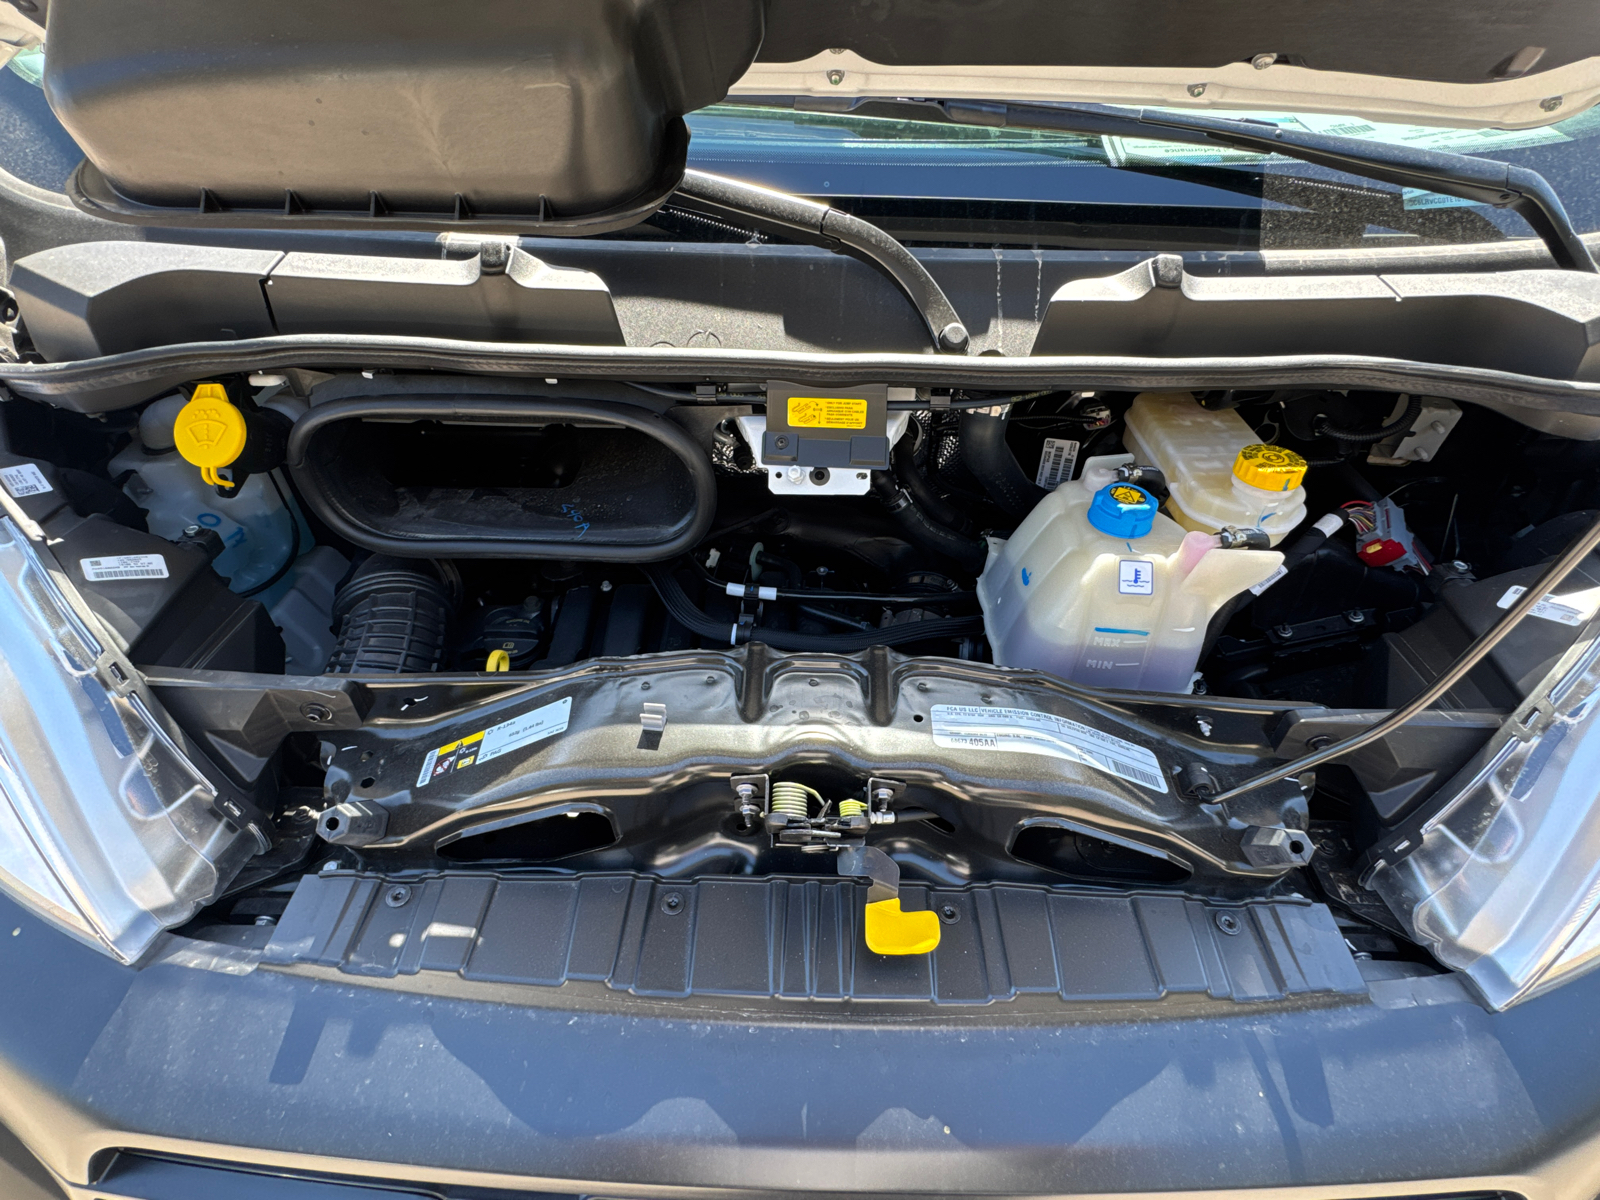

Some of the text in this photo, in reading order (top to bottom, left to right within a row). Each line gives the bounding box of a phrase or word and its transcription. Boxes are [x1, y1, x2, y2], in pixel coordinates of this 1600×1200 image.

[1093, 636, 1121, 648] MAX
[1085, 659, 1114, 670] MIN
[1030, 711, 1054, 721] CONTROL
